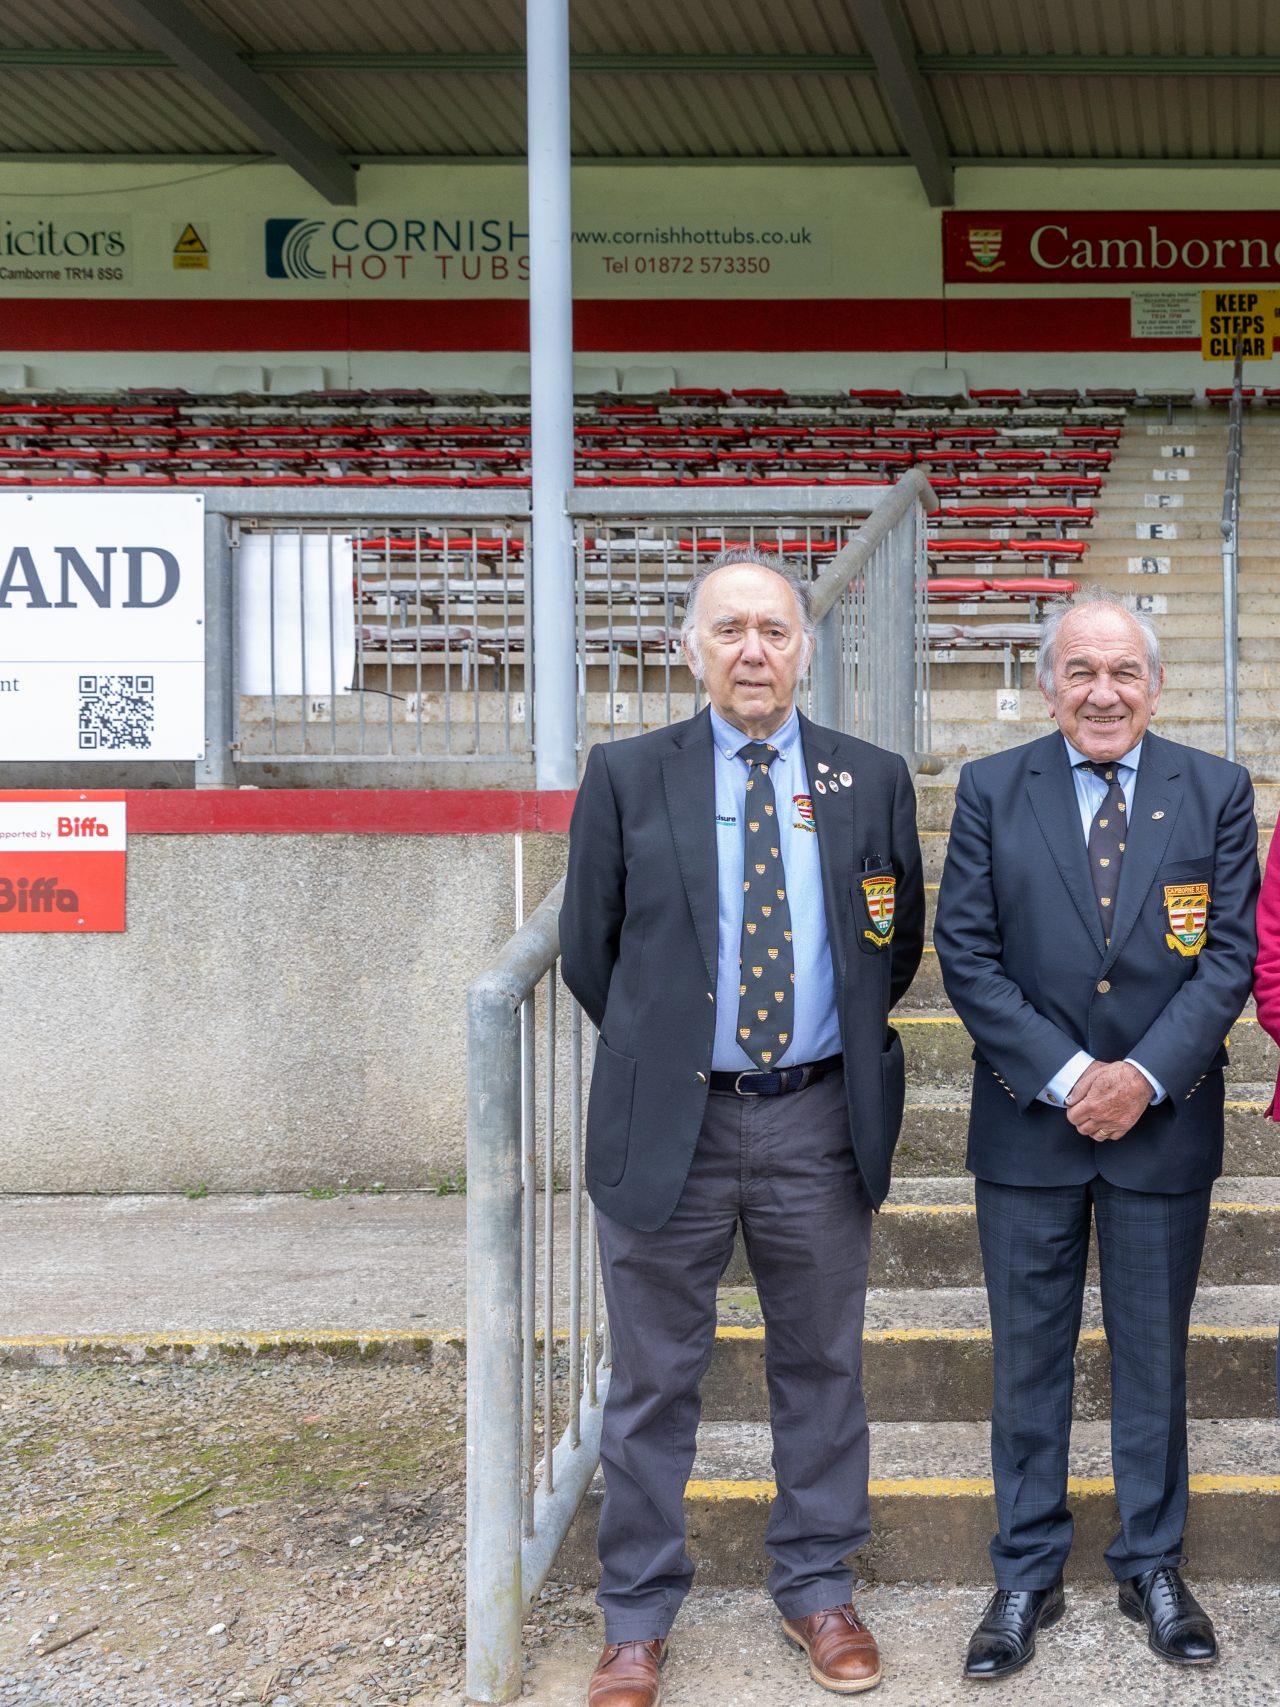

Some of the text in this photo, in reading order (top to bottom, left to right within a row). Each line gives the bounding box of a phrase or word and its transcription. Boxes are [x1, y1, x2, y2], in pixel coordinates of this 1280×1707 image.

[0, 220, 126, 257] icitors
[571, 226, 813, 245] ww.cornishhottubs.co.uk
[0, 267, 61, 280] Camborne
[64, 267, 94, 280] TR14
[333, 255, 413, 281] HOT
[602, 256, 770, 273] Tel 01872 573350
[1216, 294, 1258, 312] KEEP
[1210, 316, 1265, 334] STEPS
[1172, 446, 1186, 457] H
[1150, 524, 1163, 539] E
[0, 546, 181, 609] AND
[1136, 596, 1153, 612] C
[41, 830, 52, 840] by
[58, 817, 109, 837] Biffa
[0, 877, 79, 913] Biffa
